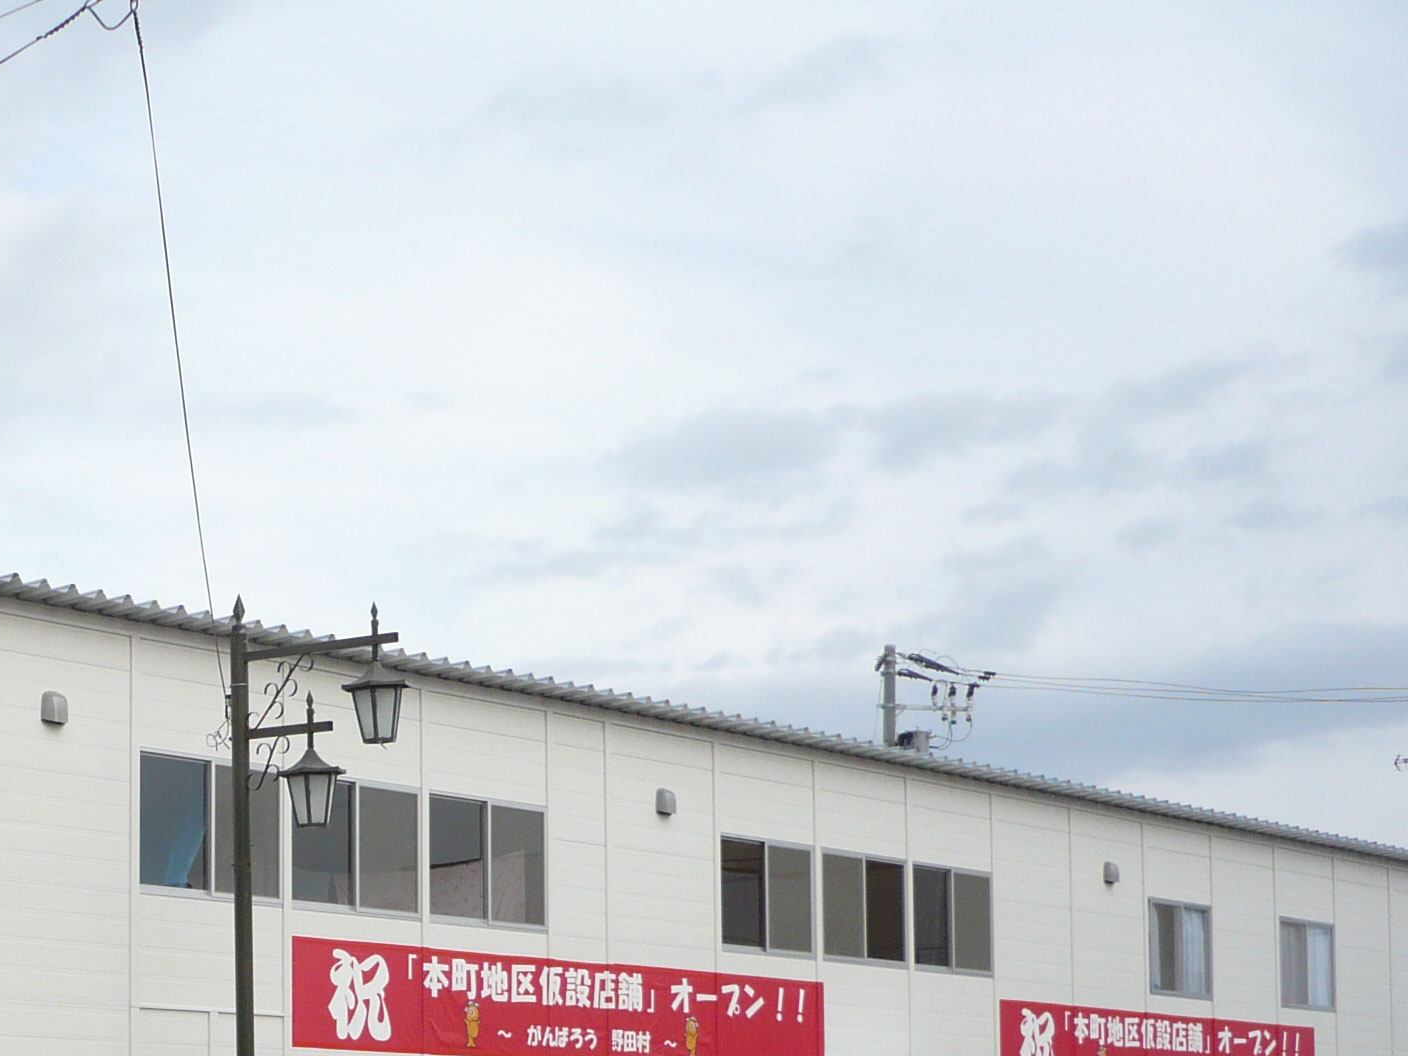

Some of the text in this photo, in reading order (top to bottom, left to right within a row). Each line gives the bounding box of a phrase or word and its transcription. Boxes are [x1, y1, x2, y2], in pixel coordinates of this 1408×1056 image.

[329, 948, 392, 1042] 祝
[527, 1025, 598, 1051] がんばろう
[611, 1029, 652, 1055] 野田村
